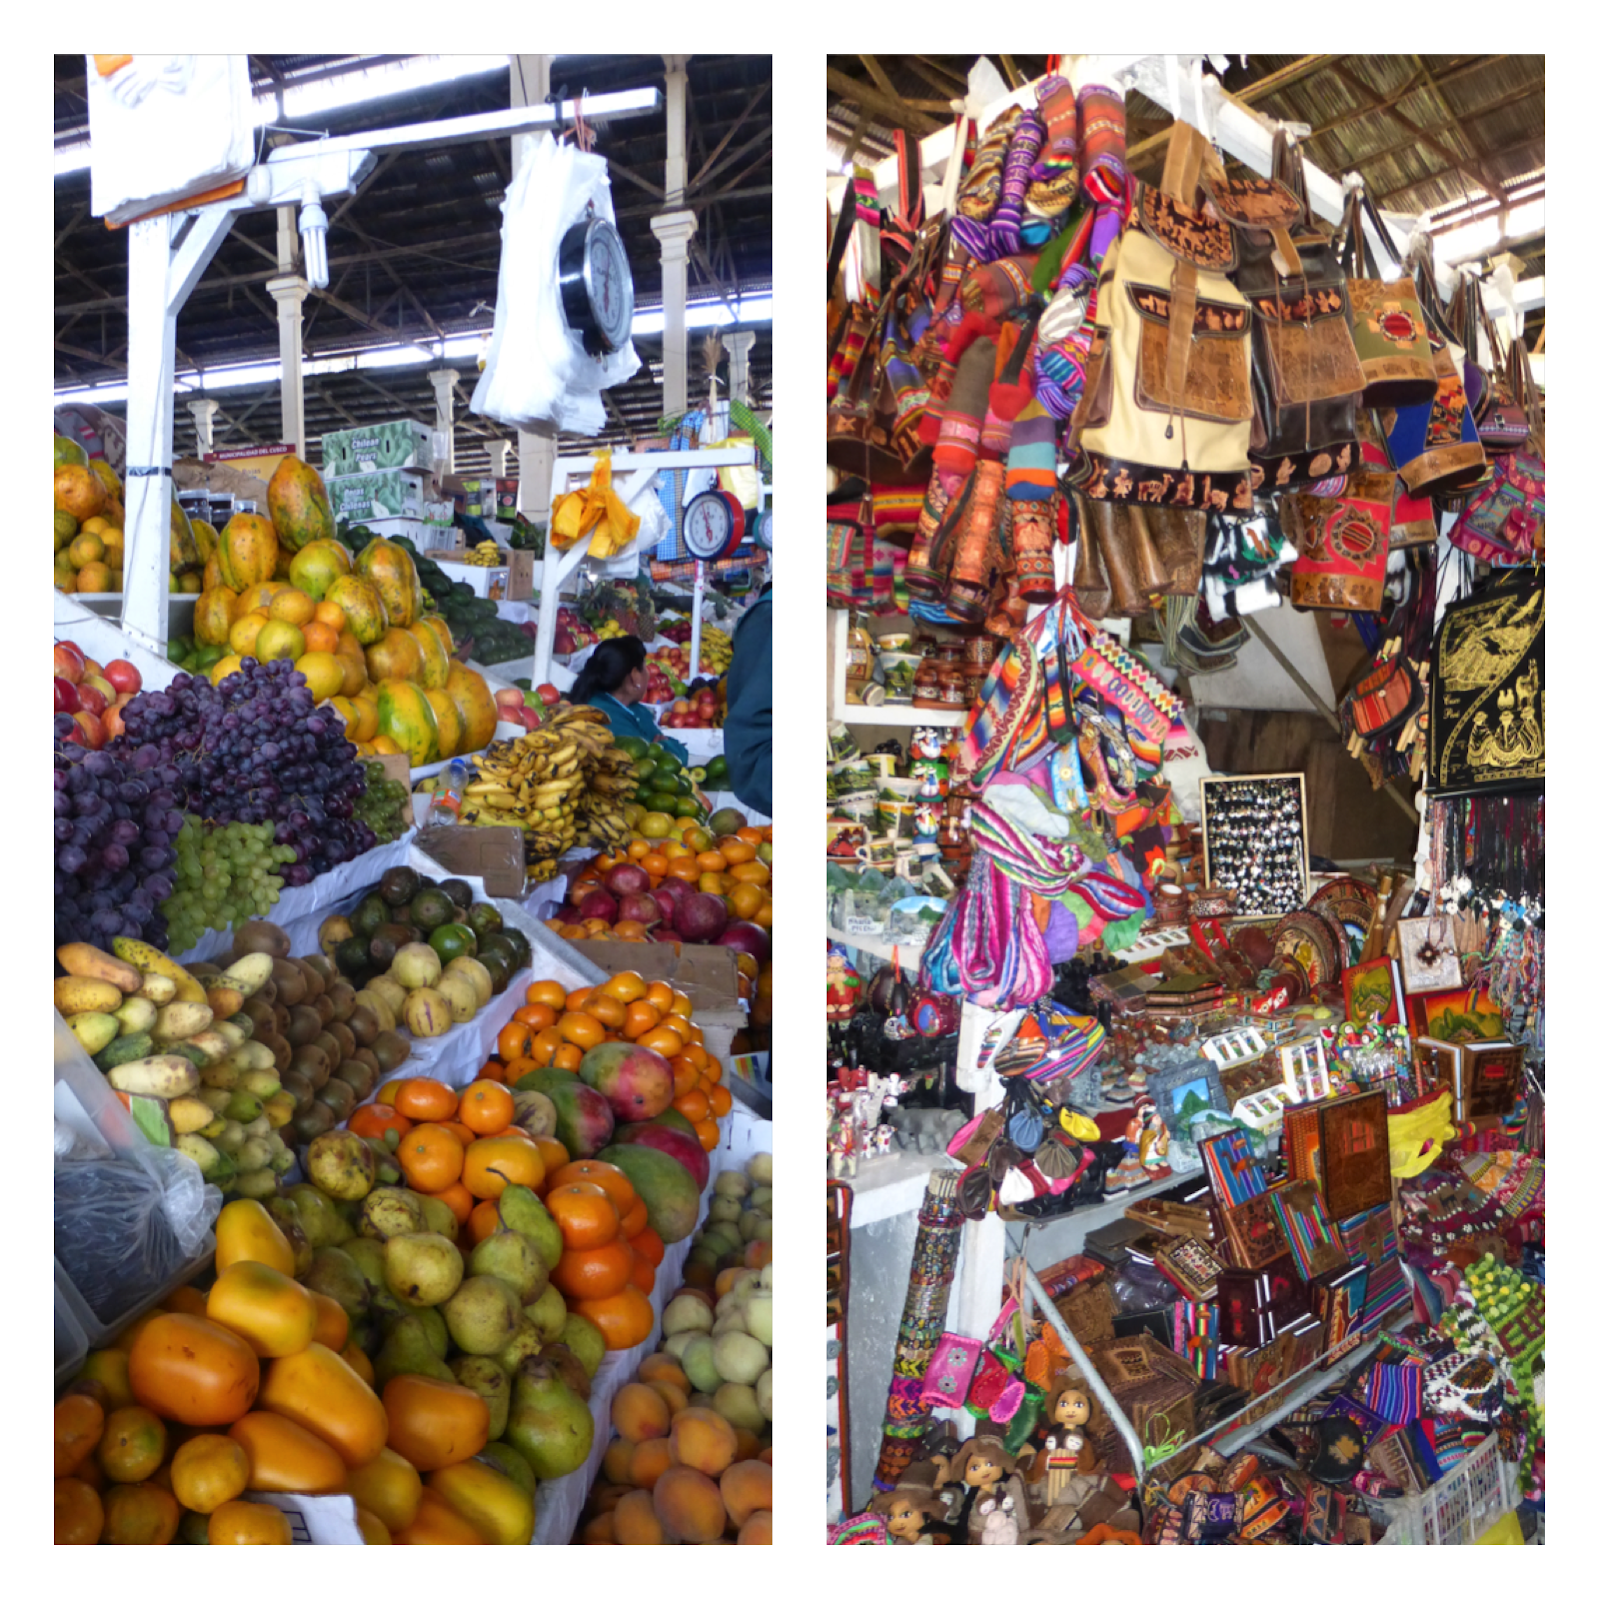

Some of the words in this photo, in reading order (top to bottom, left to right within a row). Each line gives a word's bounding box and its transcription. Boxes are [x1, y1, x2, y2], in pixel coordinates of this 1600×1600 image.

[352, 438, 379, 449] Chilean
[219, 449, 258, 459] MUNICIPALIDAD
[269, 446, 287, 454] CUSCO
[355, 452, 377, 462] Pears
[340, 501, 371, 512] Chilenas
